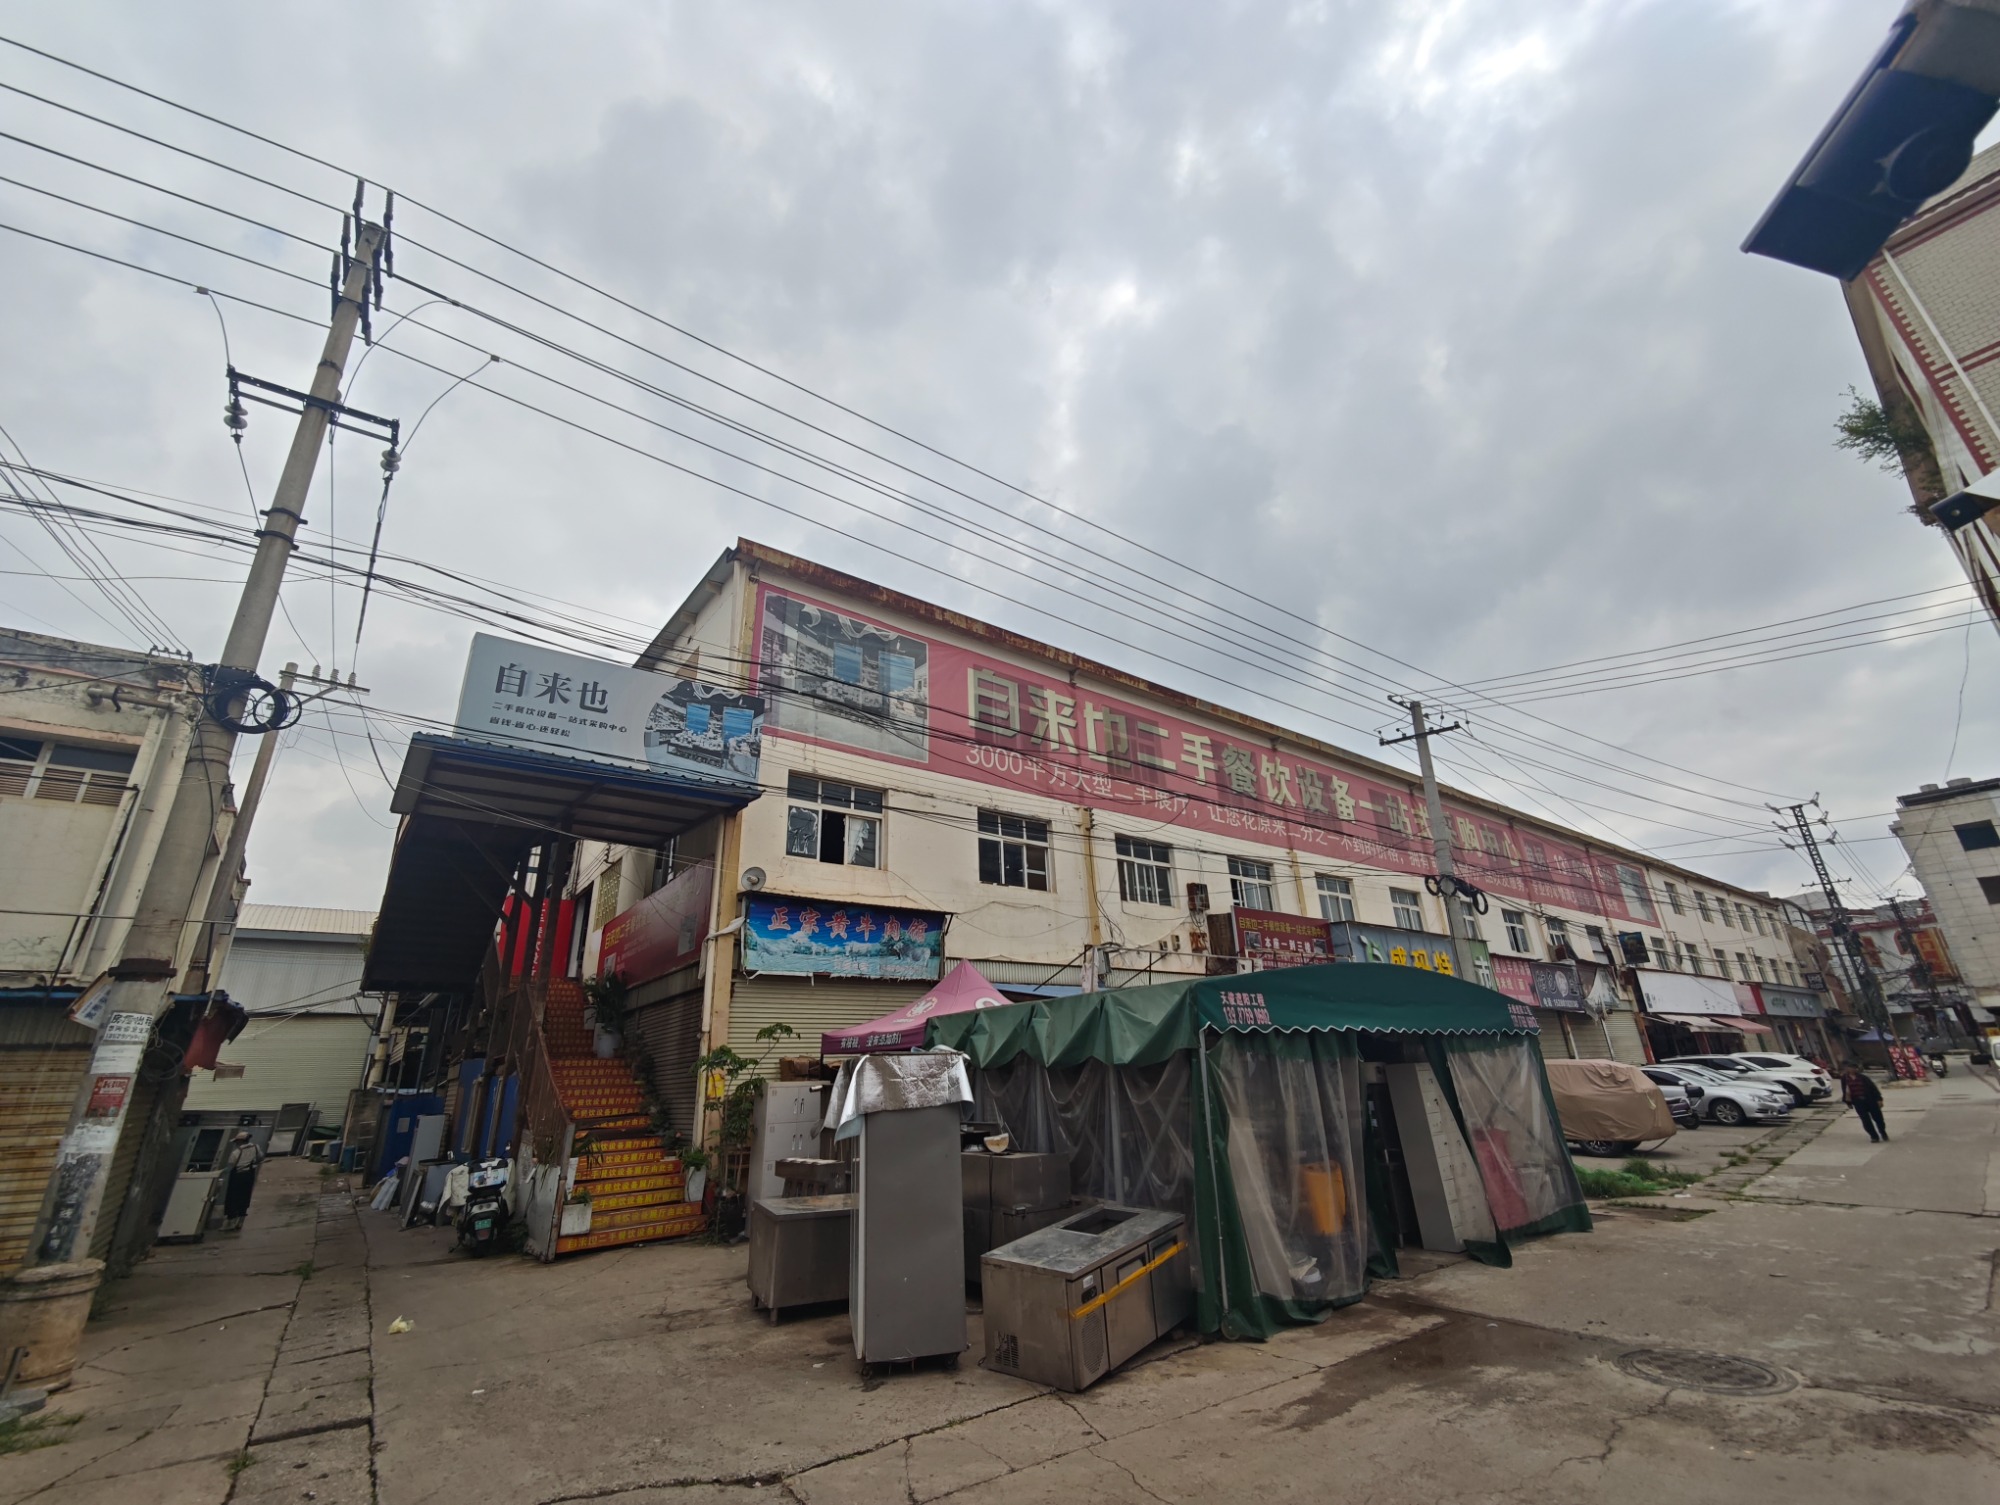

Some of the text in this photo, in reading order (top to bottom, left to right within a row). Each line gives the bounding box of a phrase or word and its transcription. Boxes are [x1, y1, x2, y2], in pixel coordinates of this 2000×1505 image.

[495, 662, 609, 714] 自来也
[492, 701, 628, 733] 二手餐饮设备一站式采购中心
[767, 906, 928, 943] 正宗黄牛肉馆
